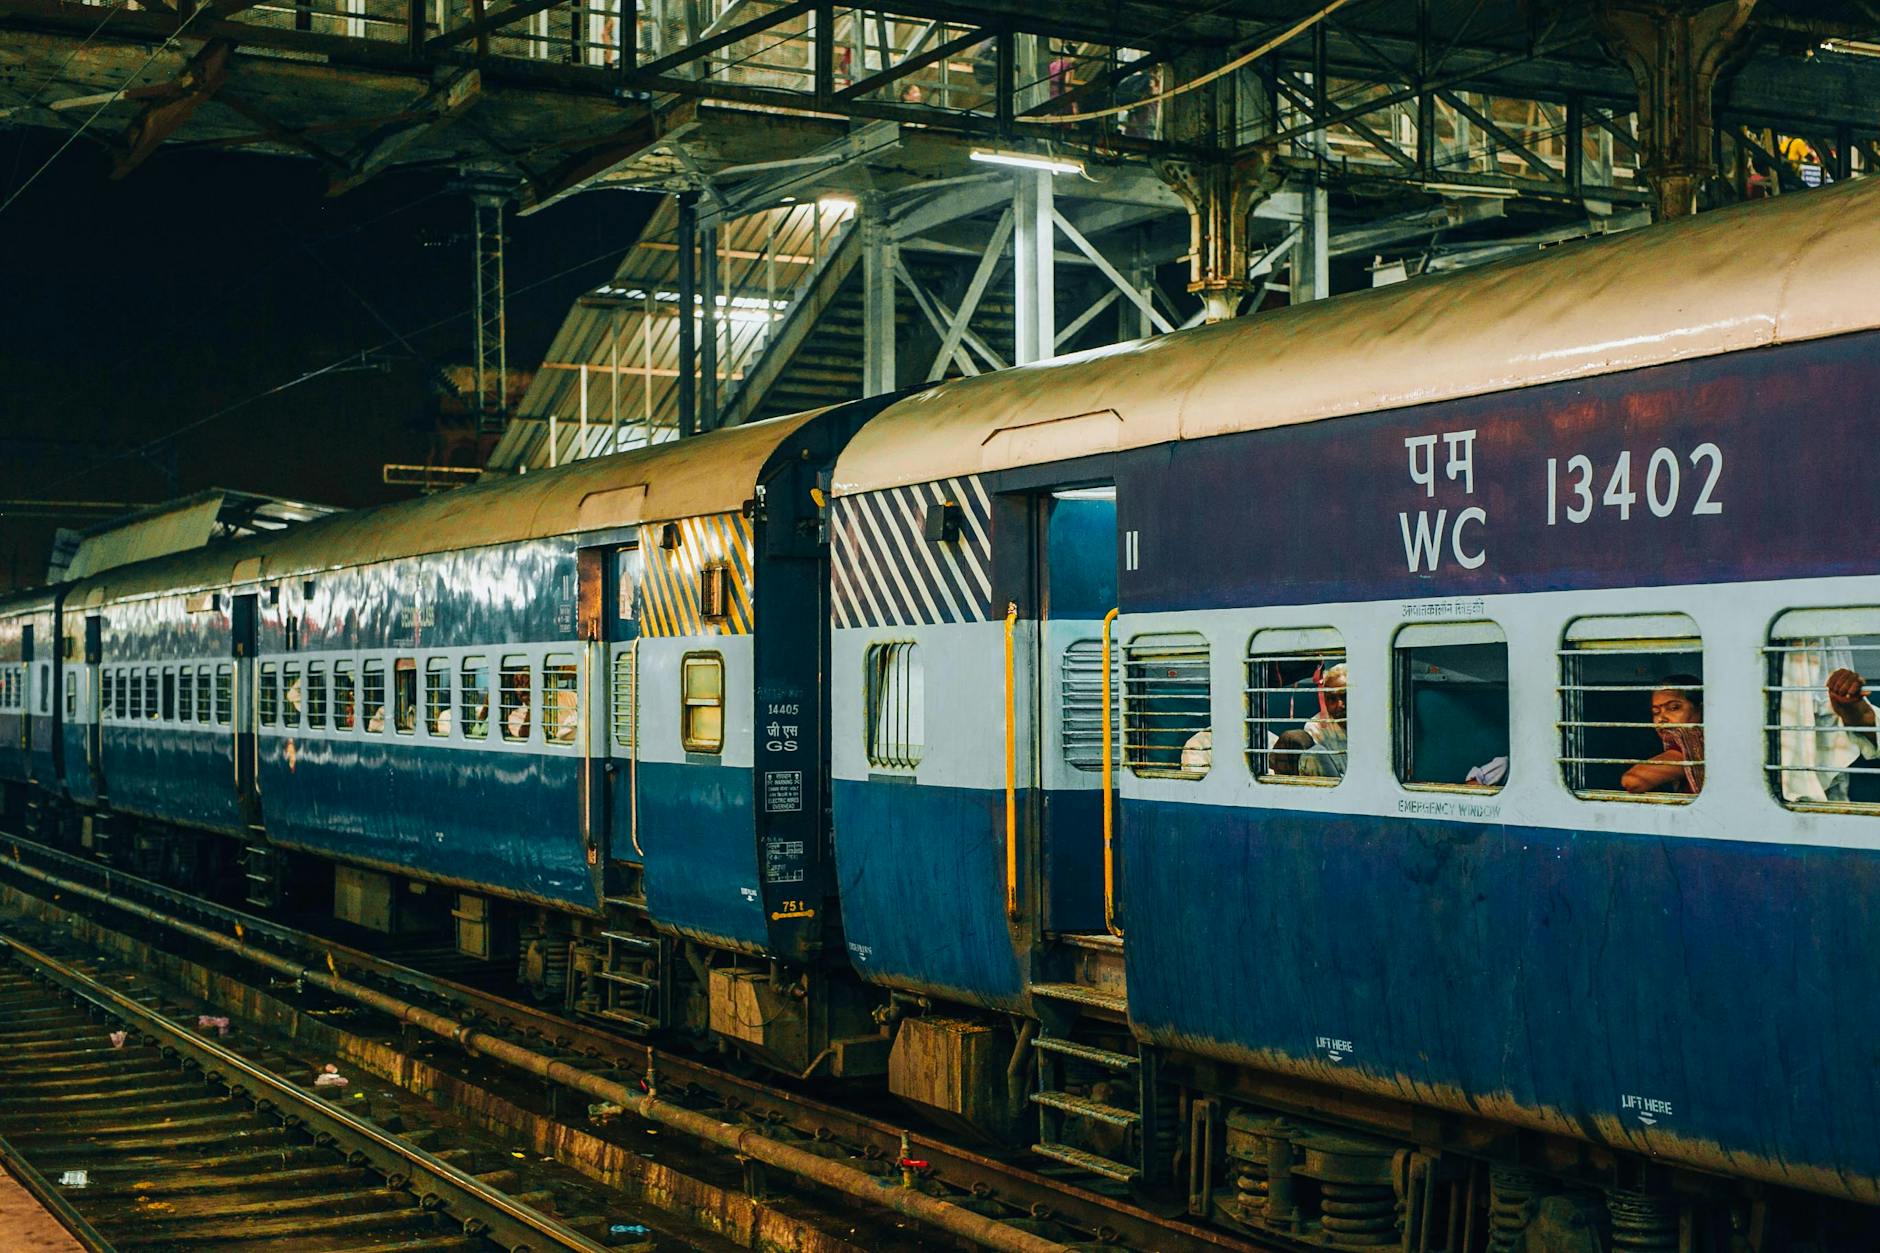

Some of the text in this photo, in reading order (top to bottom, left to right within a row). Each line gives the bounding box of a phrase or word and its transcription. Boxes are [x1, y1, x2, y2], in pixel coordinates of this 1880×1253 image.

[1547, 442, 1724, 526] 13402
[1399, 506, 1487, 573] WC
[769, 704, 799, 715] 14405
[766, 721, 798, 739] जी एस
[766, 740, 798, 752] GS
[1398, 800, 1501, 817] EMERGENCY WINDOW
[783, 901, 796, 912] 75
[1315, 1036, 1353, 1052] LIFT HERE
[1622, 1094, 1672, 1115] LIFT HERE
